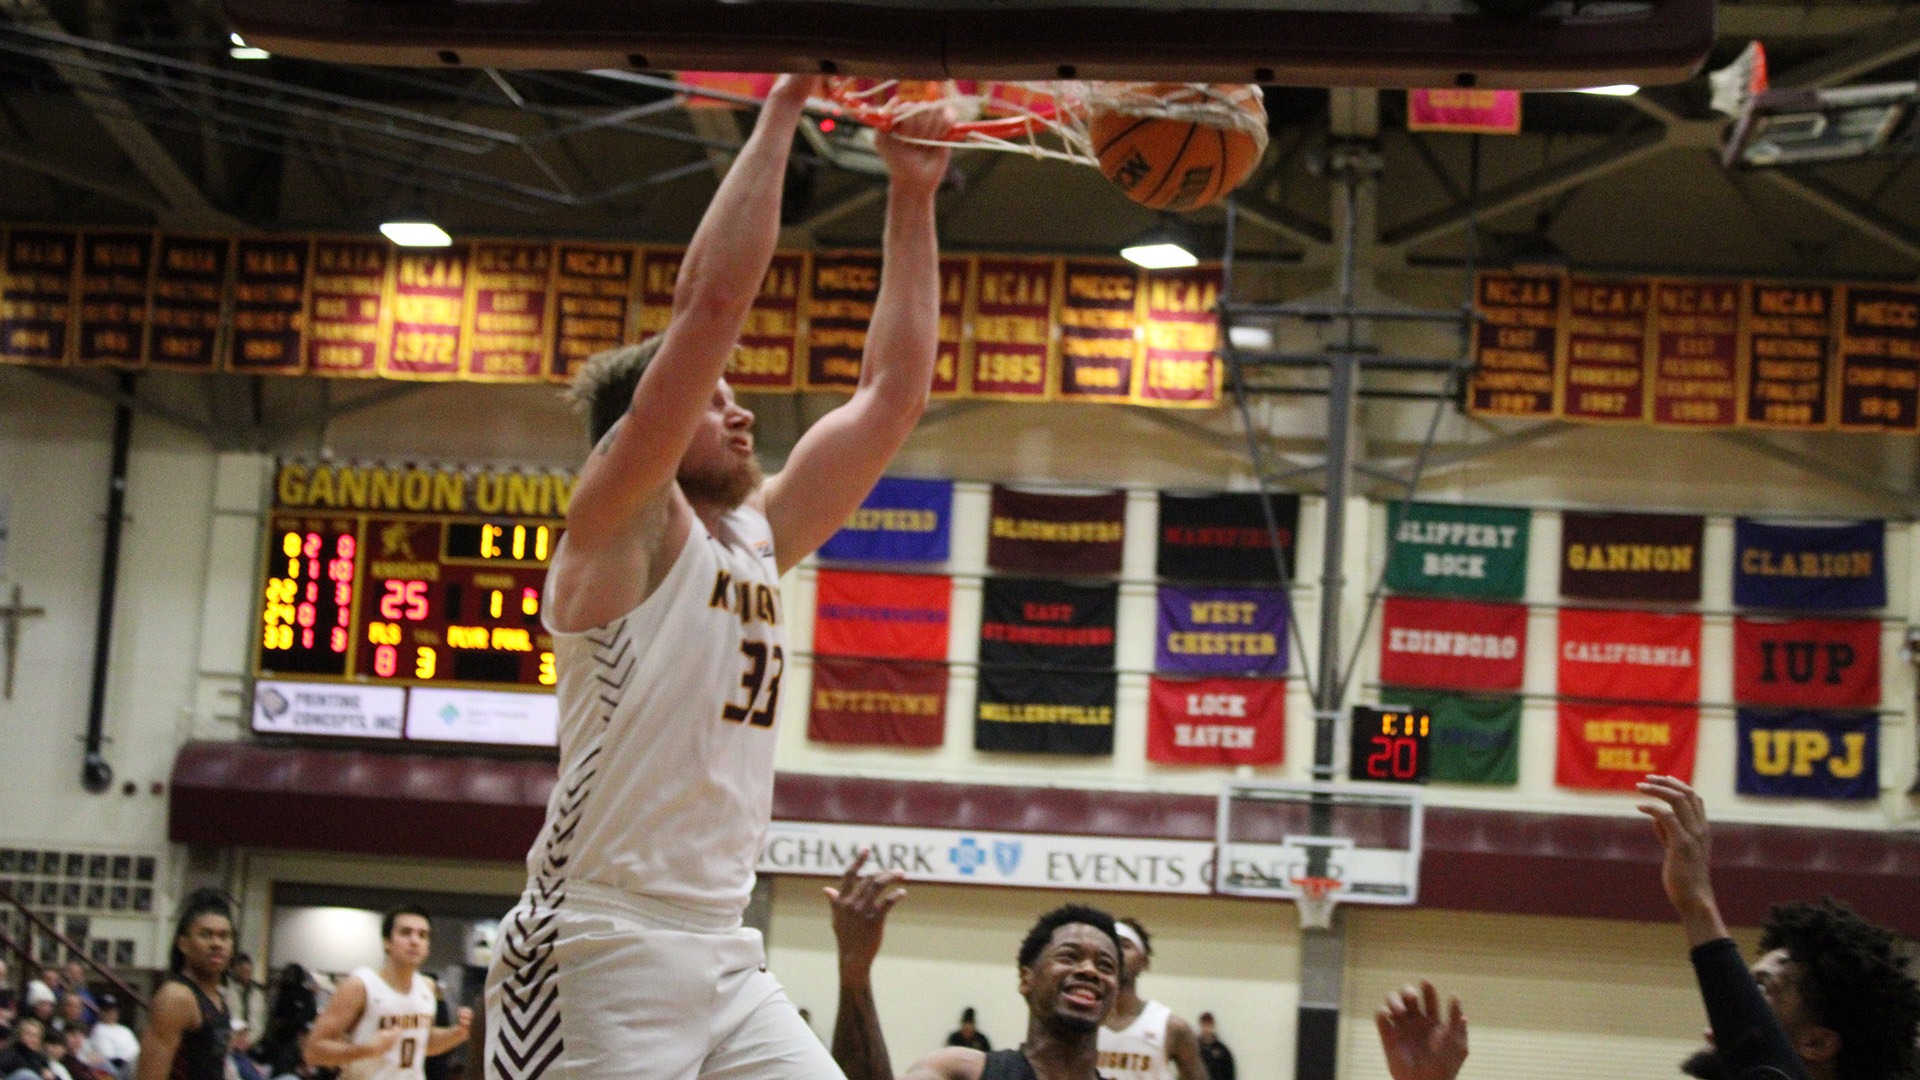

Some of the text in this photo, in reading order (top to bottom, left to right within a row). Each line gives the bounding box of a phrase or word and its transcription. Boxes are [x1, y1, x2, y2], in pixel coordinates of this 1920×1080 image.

[983, 273, 1046, 305] NCAA
[1151, 279, 1218, 312] NCAA
[1485, 280, 1551, 305] NCAA
[1574, 287, 1645, 313] NCAA
[1661, 287, 1734, 313] NCAA
[1759, 289, 1825, 314] NCAA
[394, 331, 456, 364] 1972
[978, 353, 1042, 384] 1985
[279, 466, 464, 511] GANNON
[844, 508, 938, 532] HEPHERD
[1395, 520, 1518, 550] SLIPPERY
[481, 524, 548, 561] 1:11
[1567, 542, 1695, 573] GANNON
[1422, 552, 1486, 579] ROCK
[1740, 548, 1873, 579] CLARION
[380, 580, 429, 620] 25
[490, 590, 503, 618] 1
[1190, 601, 1258, 625] WEST
[1167, 631, 1278, 657] CHESTER
[1388, 627, 1518, 661] EDINBORO
[1562, 640, 1693, 669] CALIFORNIA
[374, 644, 397, 677] 8
[415, 646, 436, 679] 3
[538, 652, 558, 685] 3
[1757, 640, 1857, 684] IUP
[721, 637, 784, 730] 33
[1186, 693, 1248, 719] LOCK
[1173, 724, 1258, 750] HAVEN
[1381, 713, 1430, 738] 1:11
[1583, 719, 1671, 746] SETON
[1367, 736, 1418, 779] 20
[1595, 746, 1657, 773] HILL
[1750, 728, 1867, 779] UPJ
[1047, 850, 1185, 888] EVENTS
[400, 1038, 416, 1068] 0
